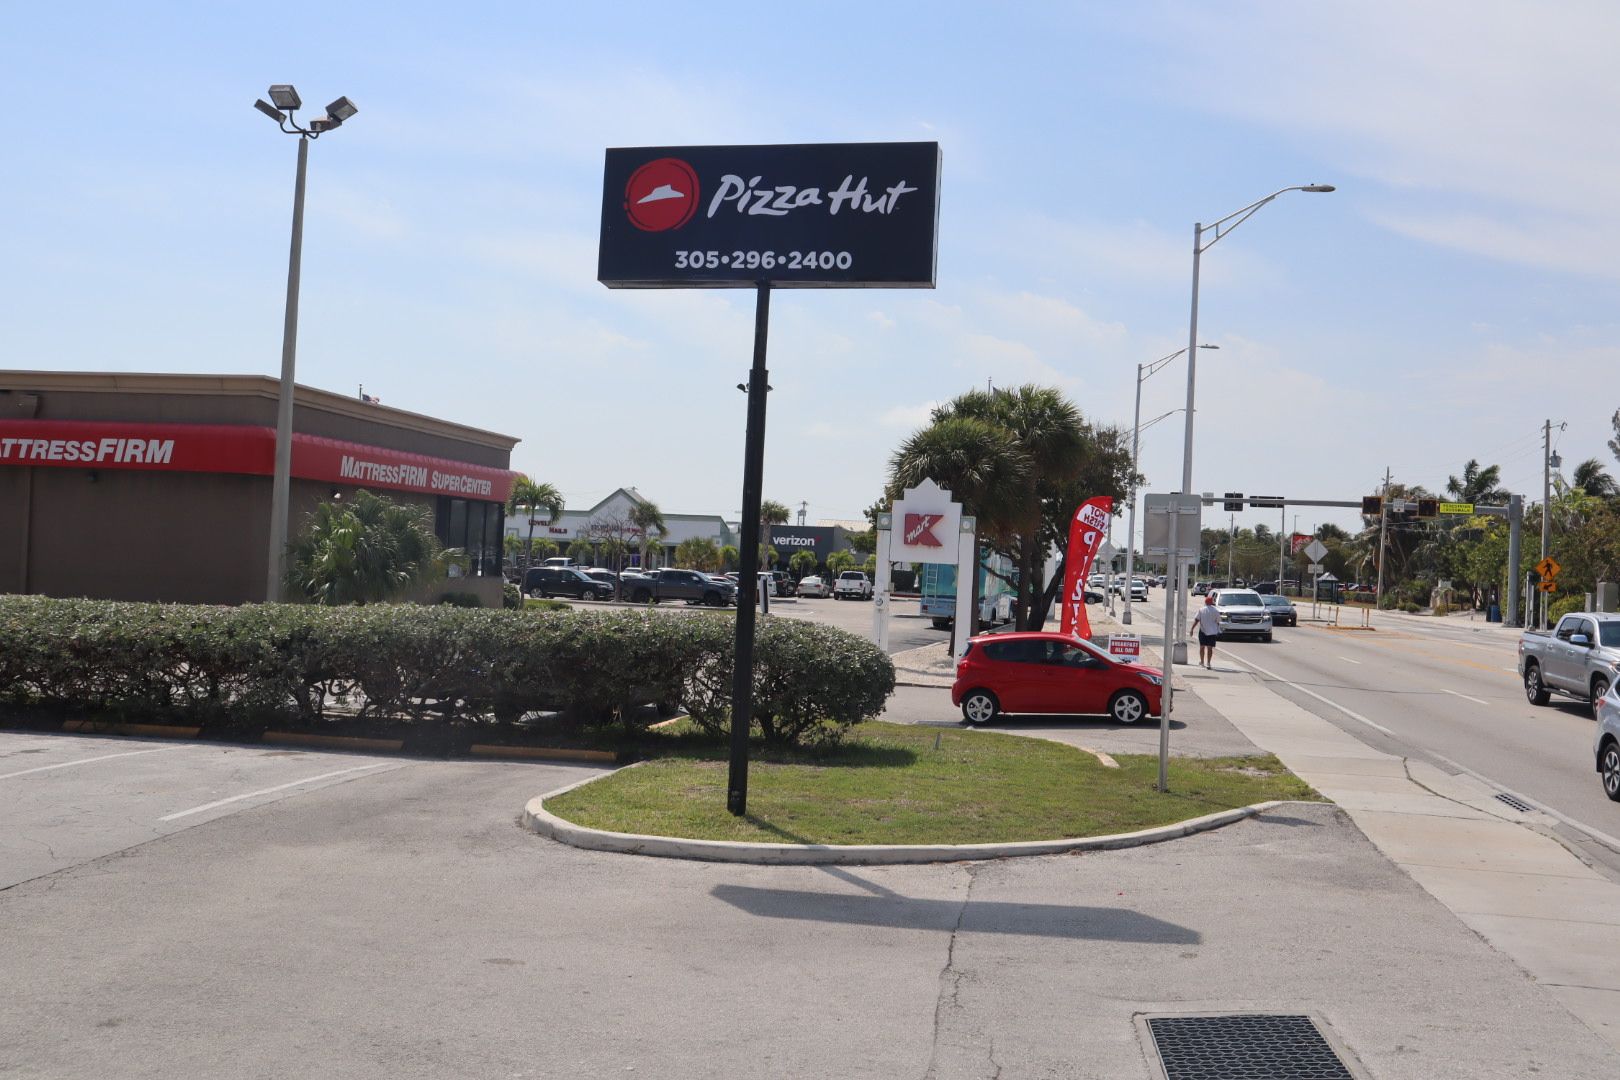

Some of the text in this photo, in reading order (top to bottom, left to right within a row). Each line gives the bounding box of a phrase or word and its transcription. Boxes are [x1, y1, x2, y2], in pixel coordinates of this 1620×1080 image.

[707, 174, 919, 218] Pizza Hut
[0, 438, 174, 464] TTRESSFIRM
[431, 470, 492, 496] SUPERCENTER
[528, 519, 551, 527] LOVEL
[772, 534, 815, 546] verizon
